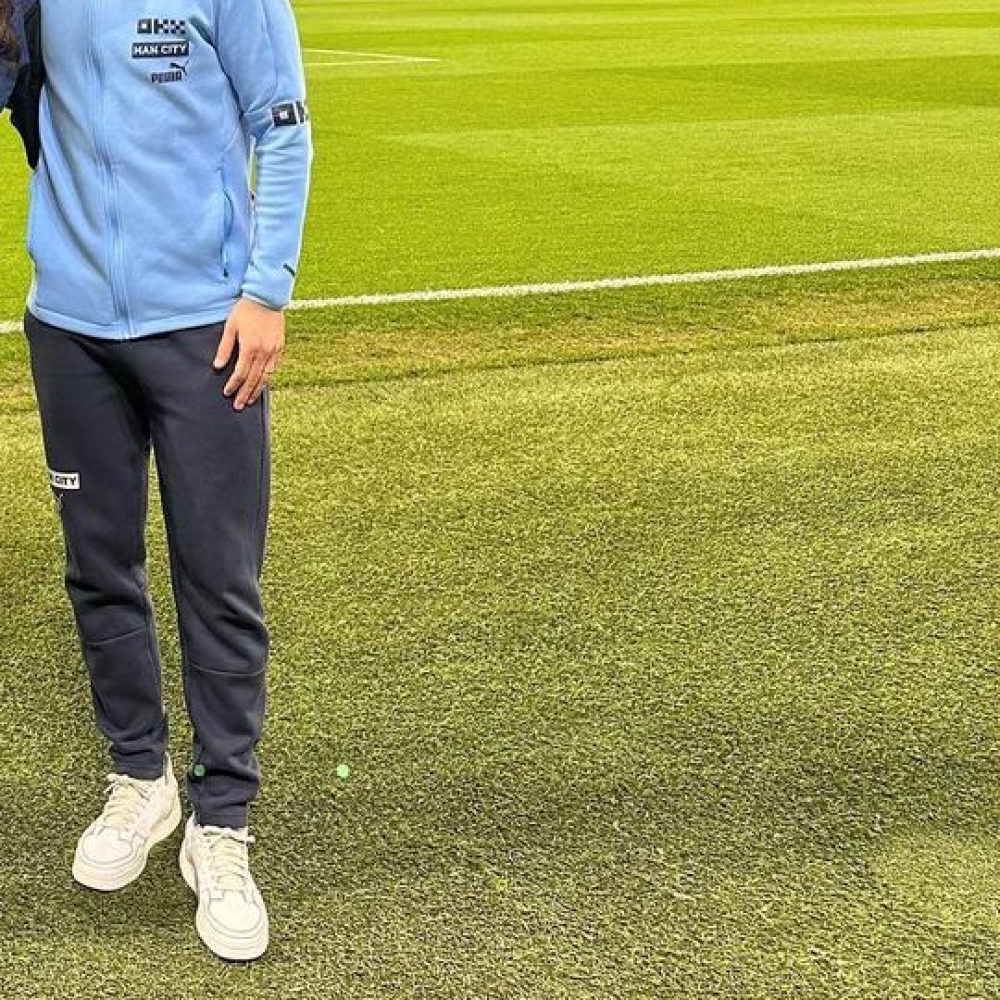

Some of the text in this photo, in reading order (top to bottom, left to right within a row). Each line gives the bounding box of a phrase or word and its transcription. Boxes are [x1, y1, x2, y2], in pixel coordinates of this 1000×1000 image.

[160, 44, 186, 55] CITY
[151, 71, 182, 83] PUMA
[55, 475, 77, 486] CITY
